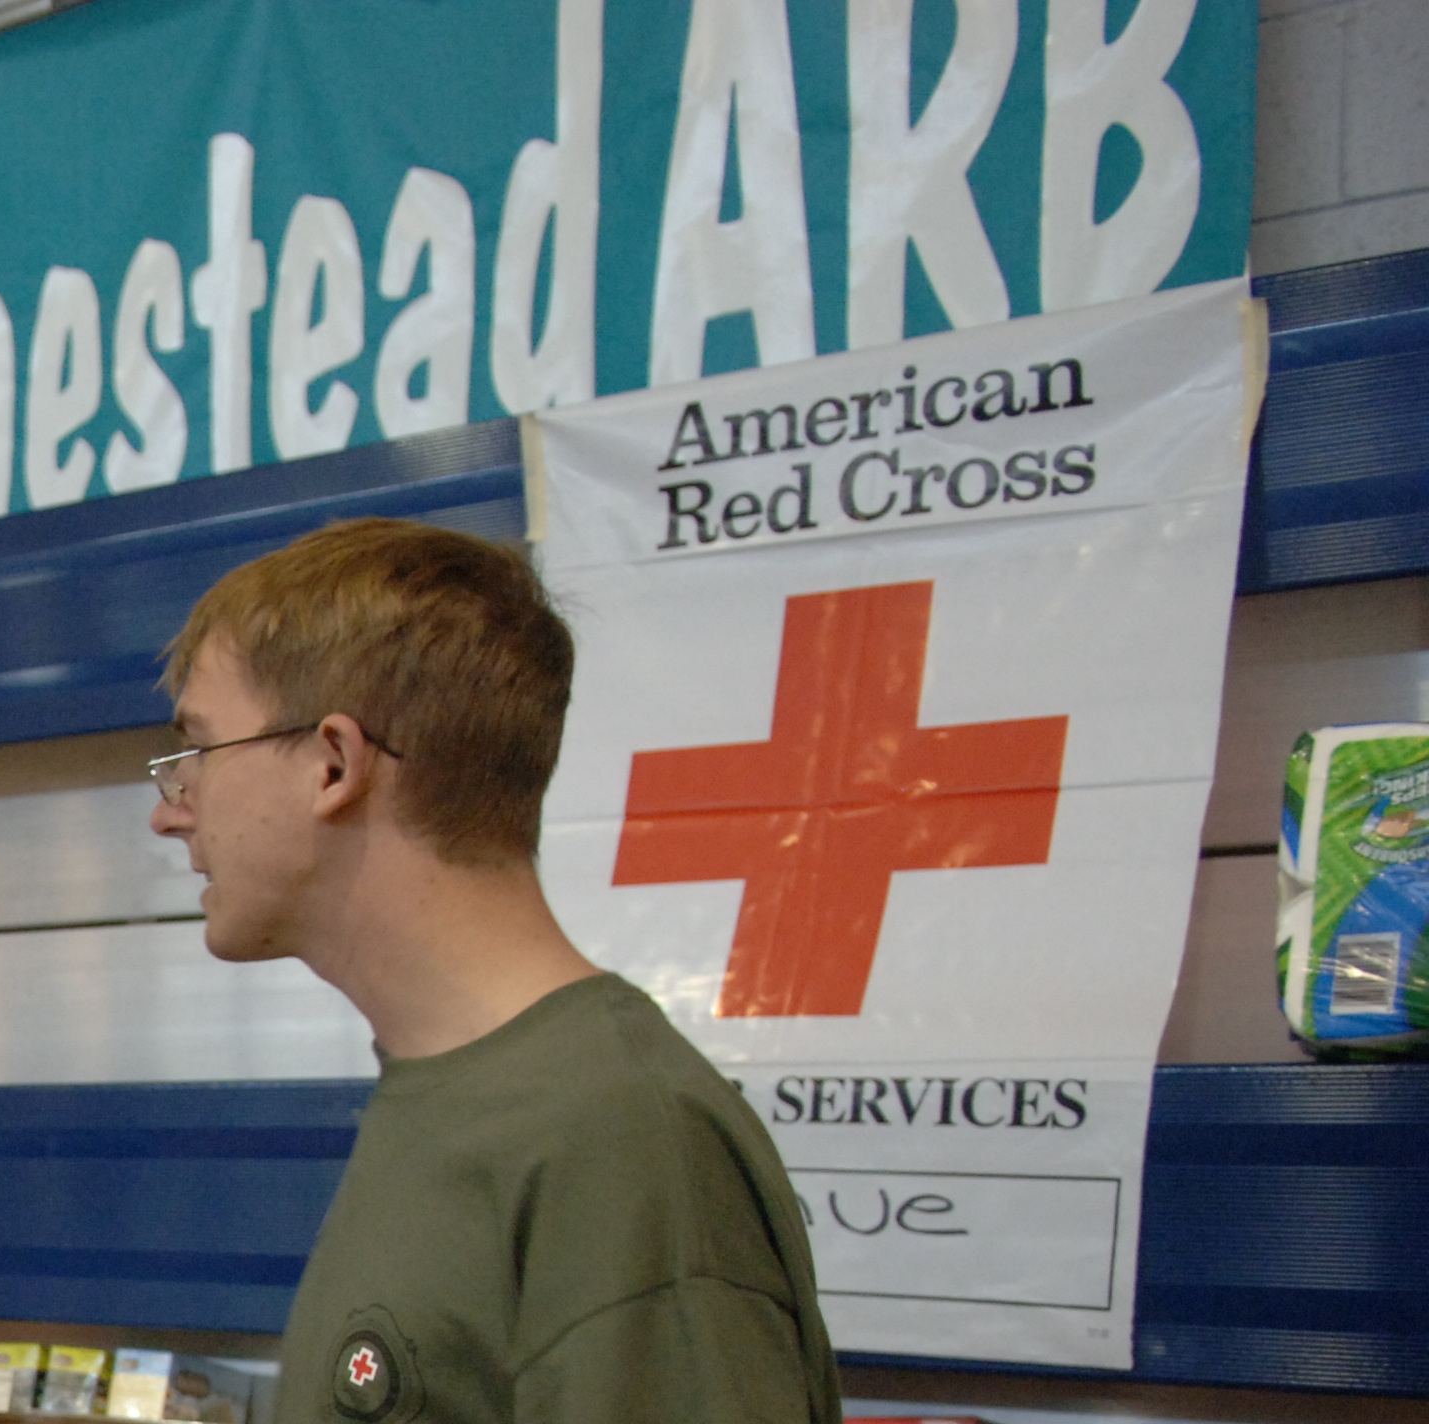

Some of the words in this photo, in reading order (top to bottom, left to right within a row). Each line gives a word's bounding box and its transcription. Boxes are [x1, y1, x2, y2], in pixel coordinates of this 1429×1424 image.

[650, 0, 1202, 388] ARB
[657, 357, 1093, 473] American
[657, 463, 813, 550] Red
[838, 442, 1097, 525] Cross
[772, 1075, 1087, 1130] SERVICES
